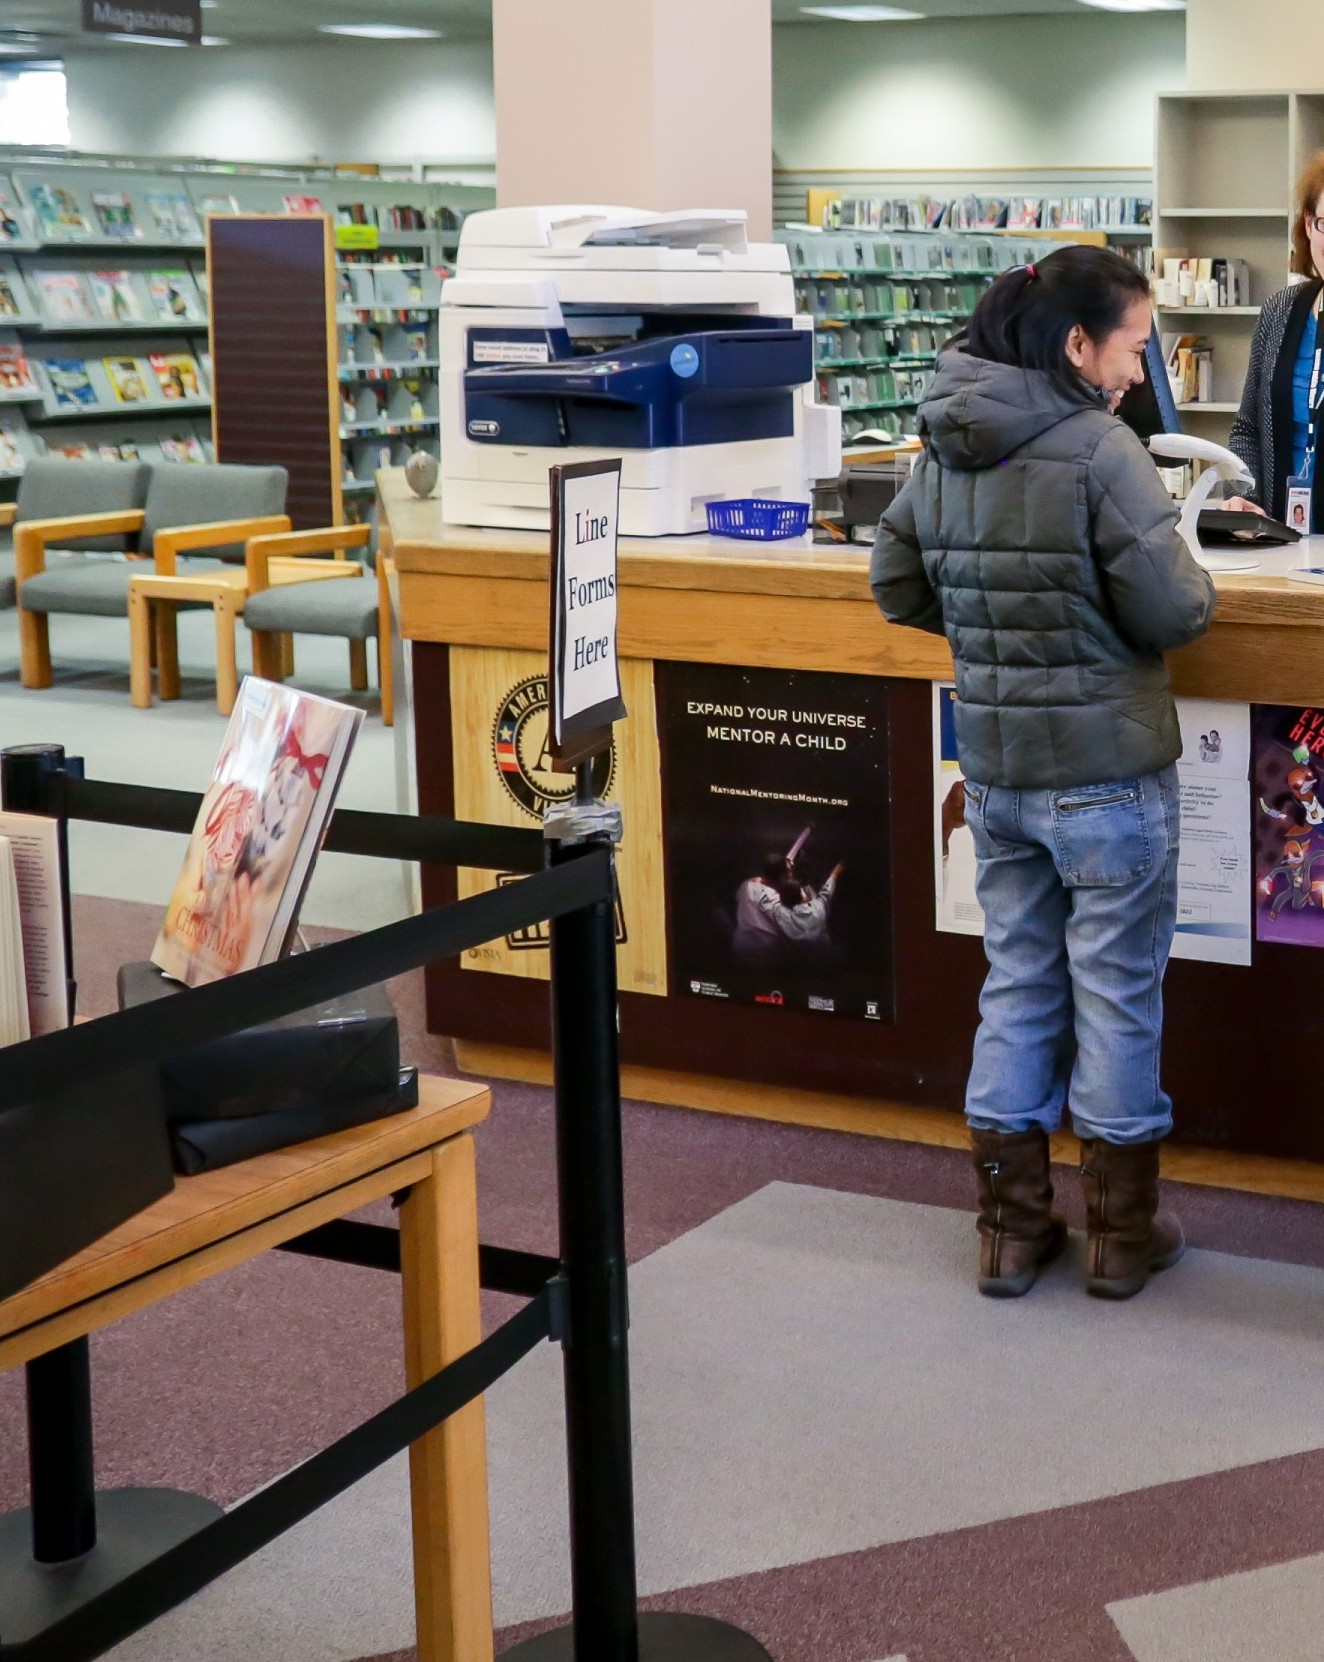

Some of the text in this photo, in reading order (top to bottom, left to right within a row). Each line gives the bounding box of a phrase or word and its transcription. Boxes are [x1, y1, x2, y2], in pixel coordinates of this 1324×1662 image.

[92, 1, 194, 33] Magazines
[575, 509, 608, 545] Line
[568, 573, 614, 611] Forms
[573, 632, 609, 672] Here
[508, 683, 547, 719] AMER
[687, 701, 866, 728] EXPAND YOUR UNIVERSE
[707, 726, 847, 751] MENTOR A CHILD
[175, 907, 242, 964] CHRISTMAS
